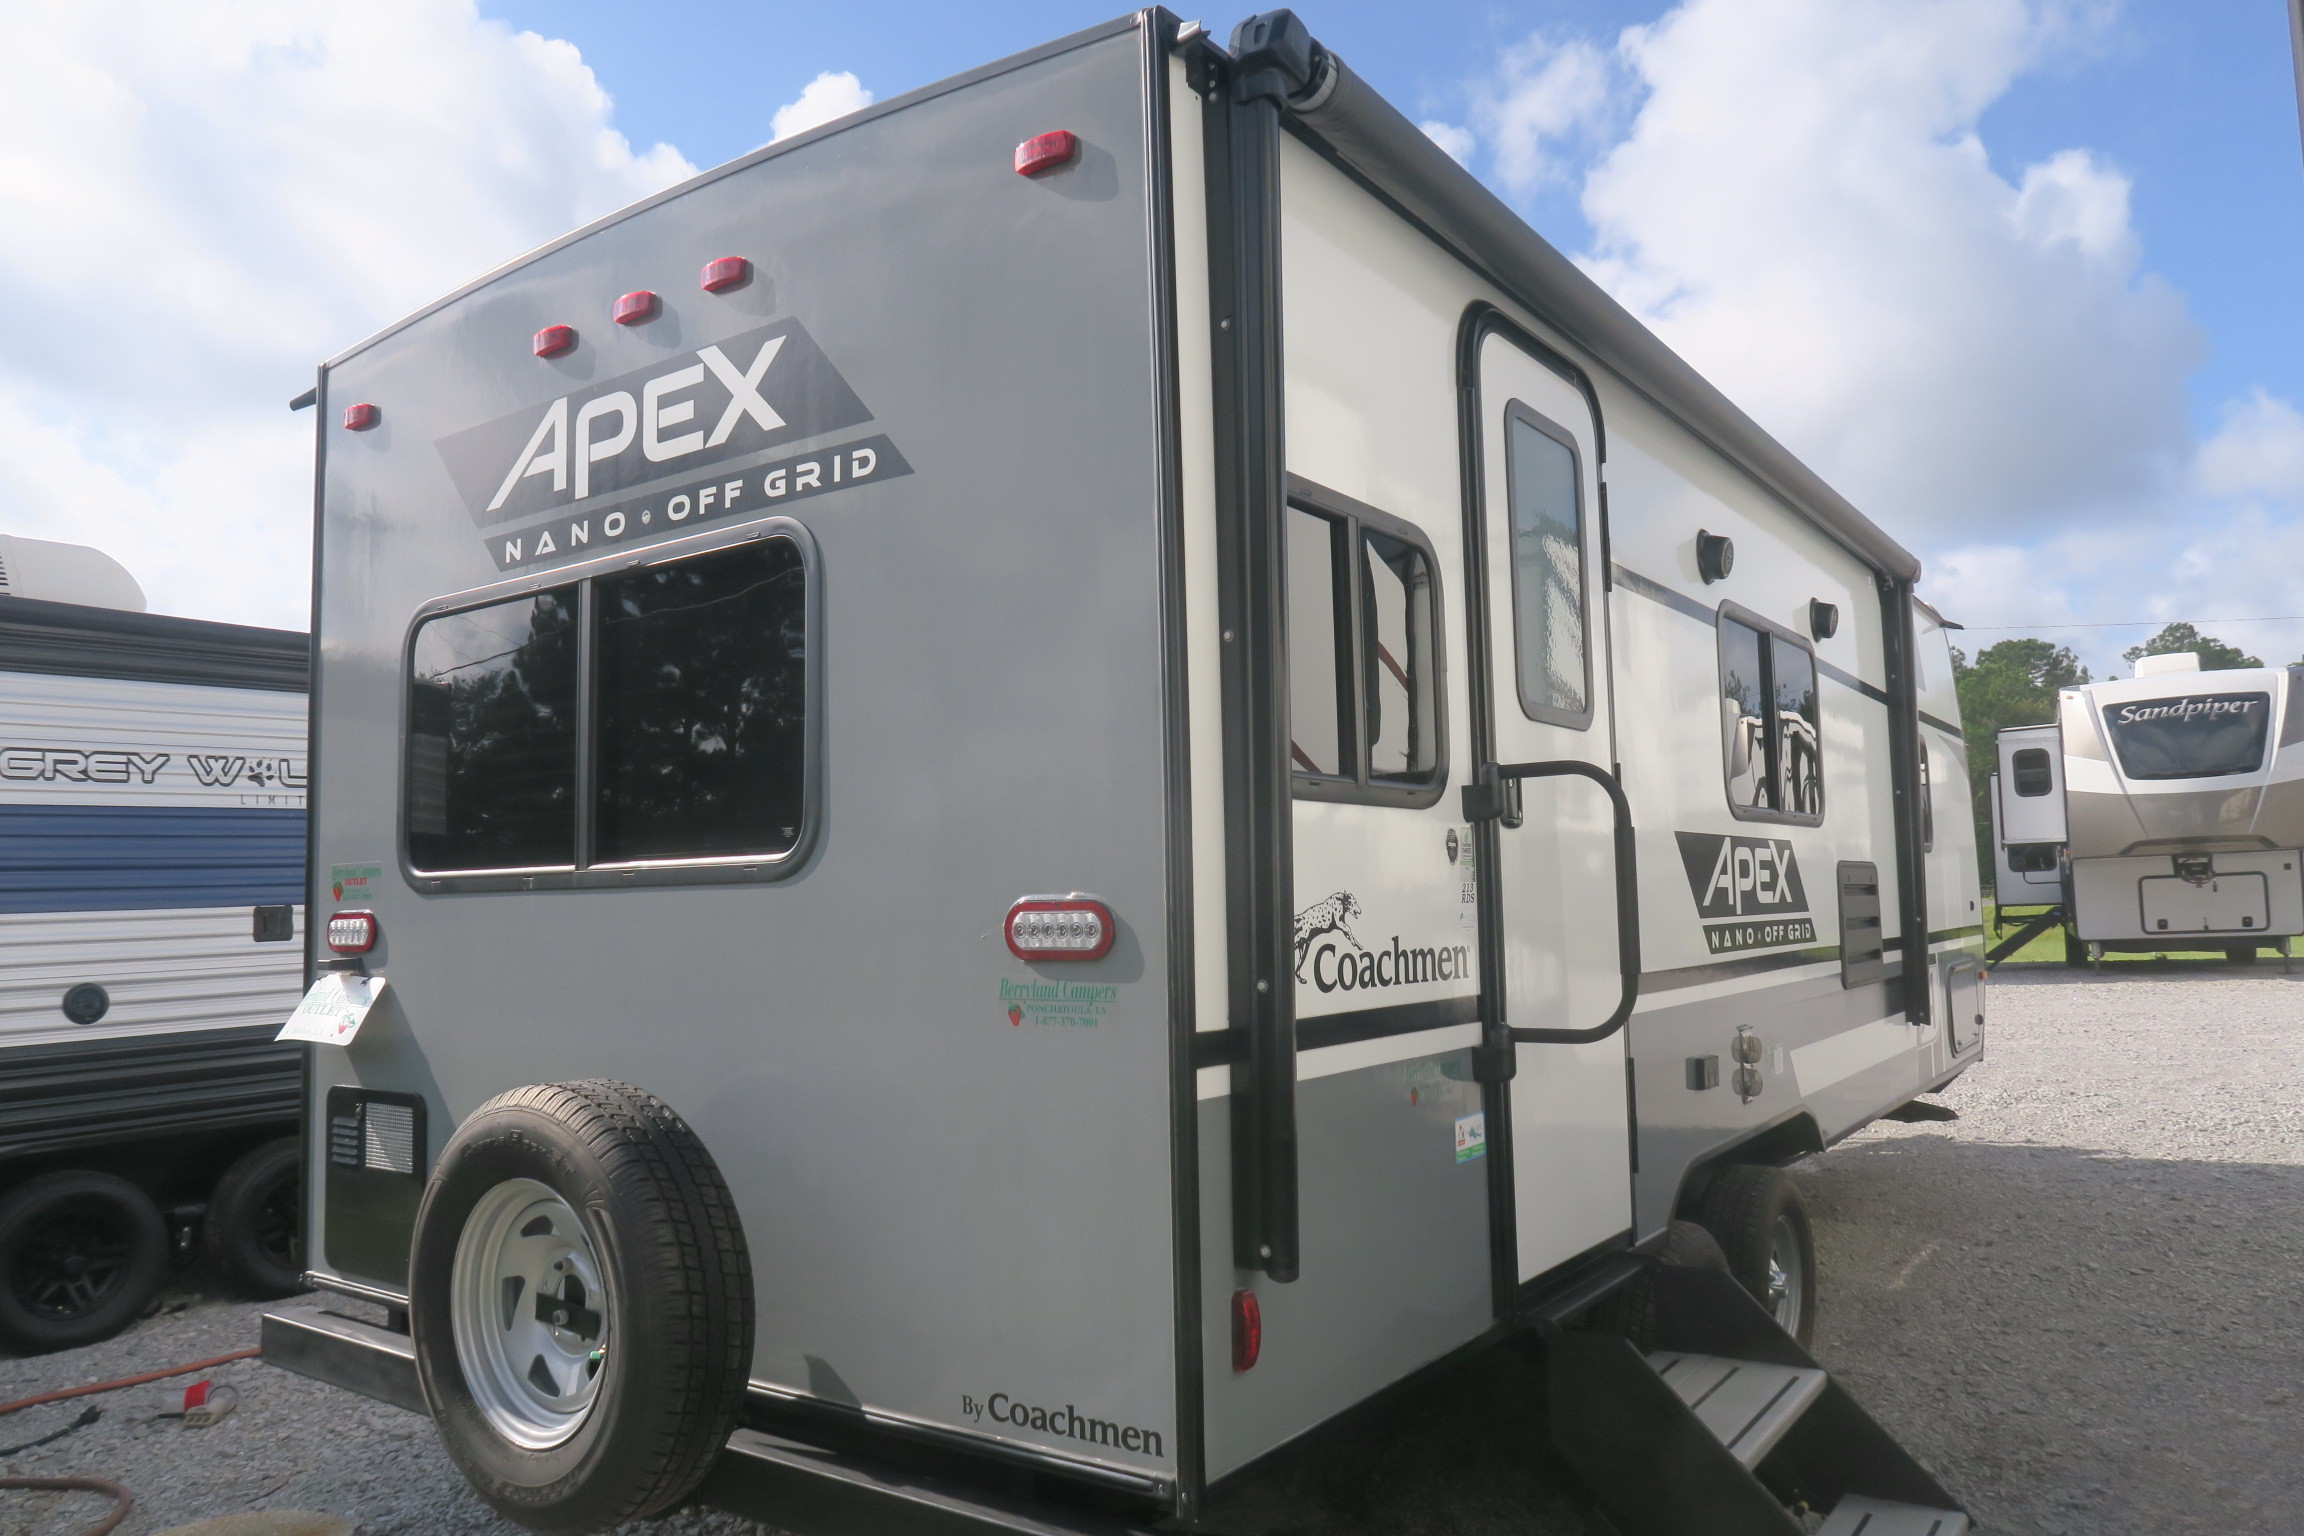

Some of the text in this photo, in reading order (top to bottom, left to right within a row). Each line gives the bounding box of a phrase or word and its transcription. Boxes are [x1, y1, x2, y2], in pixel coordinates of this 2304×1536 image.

[486, 334, 788, 512] APEX
[504, 448, 877, 563] NANO OFF GRID
[2117, 698, 2259, 724] Sandpiper
[0, 747, 170, 784] GREY
[240, 794, 305, 806] LIMIT
[1461, 882, 1474, 893] 213
[1702, 836, 1793, 915] APEX
[1461, 893, 1475, 904] RDS
[1711, 923, 1811, 949] NANO OFF GRID
[1313, 935, 1469, 994] Coachmen
[999, 977, 1118, 1006] Berryland Campers
[961, 1392, 1165, 1458] By Coachmen
